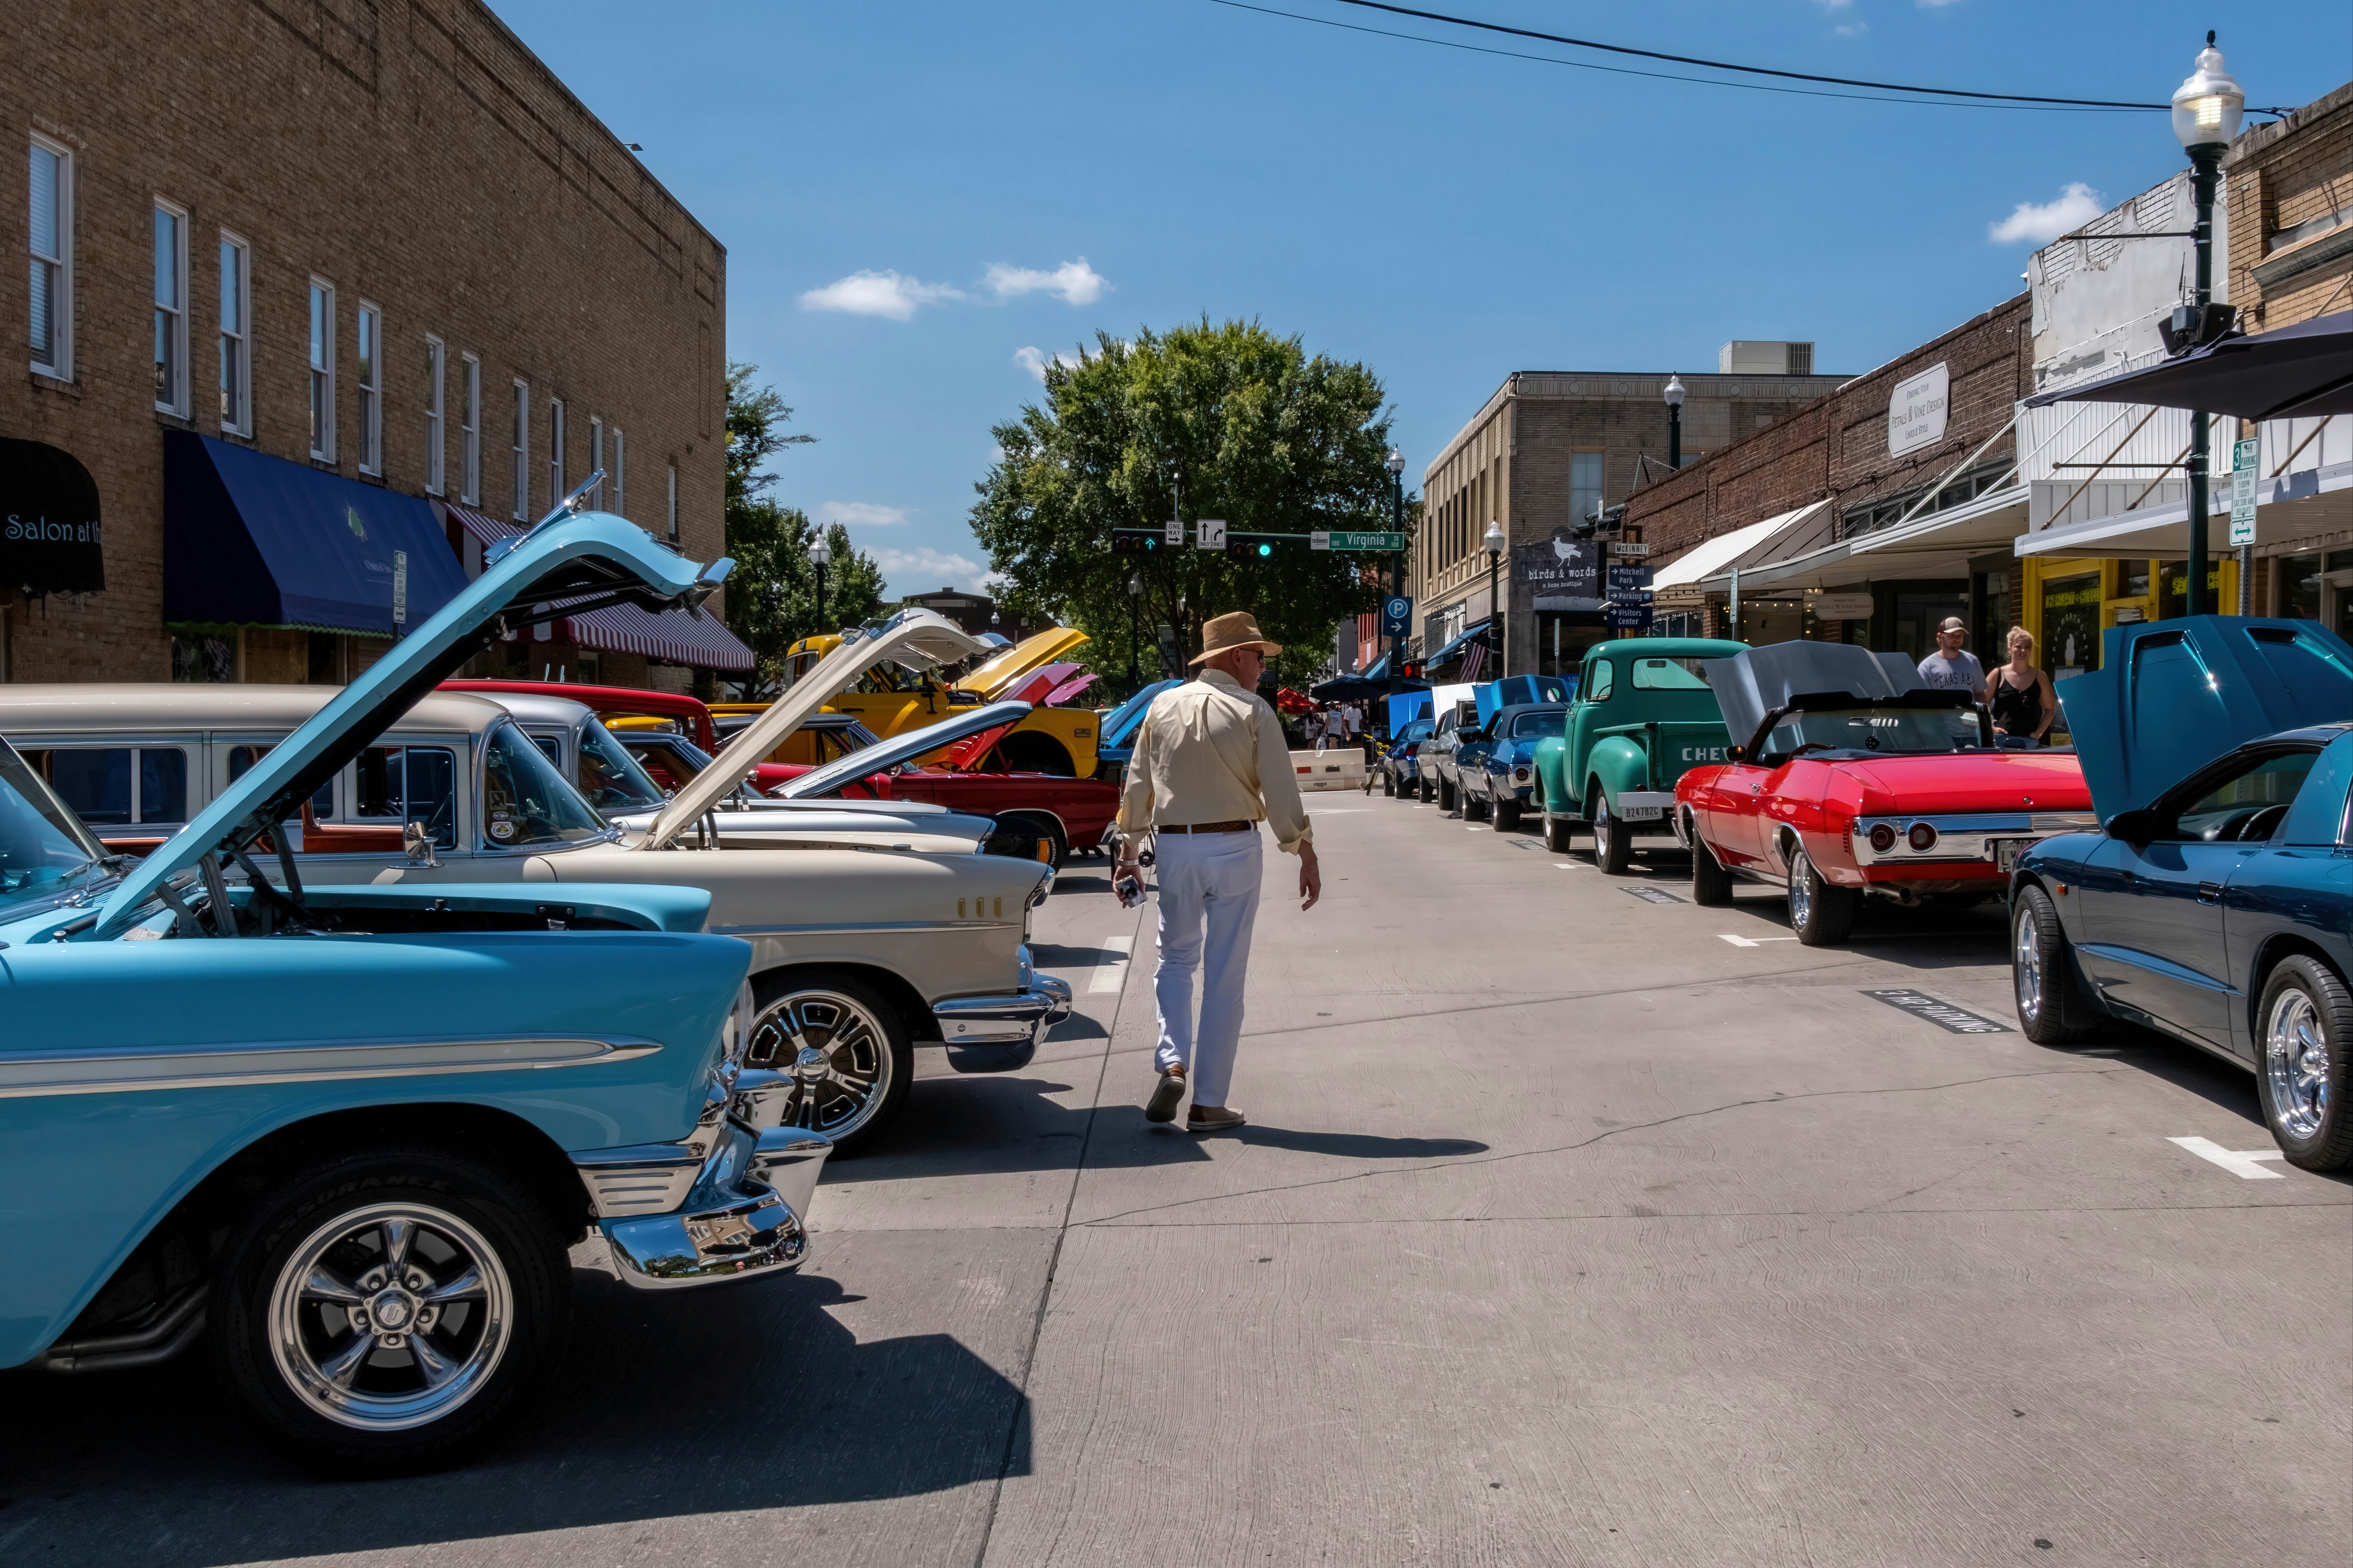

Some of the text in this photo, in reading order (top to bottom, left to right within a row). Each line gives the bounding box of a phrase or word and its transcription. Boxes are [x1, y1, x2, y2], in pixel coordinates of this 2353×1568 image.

[2234, 447, 2240, 466] 3
[6, 515, 73, 541] Salon
[78, 521, 90, 542] at
[1347, 534, 1385, 548] Virginia
[1529, 567, 1596, 580] birds & words
[1619, 592, 1642, 601] Parking
[1394, 602, 1403, 614] P
[1935, 672, 1958, 689] TEXAS
[1626, 807, 1658, 817] B24782C
